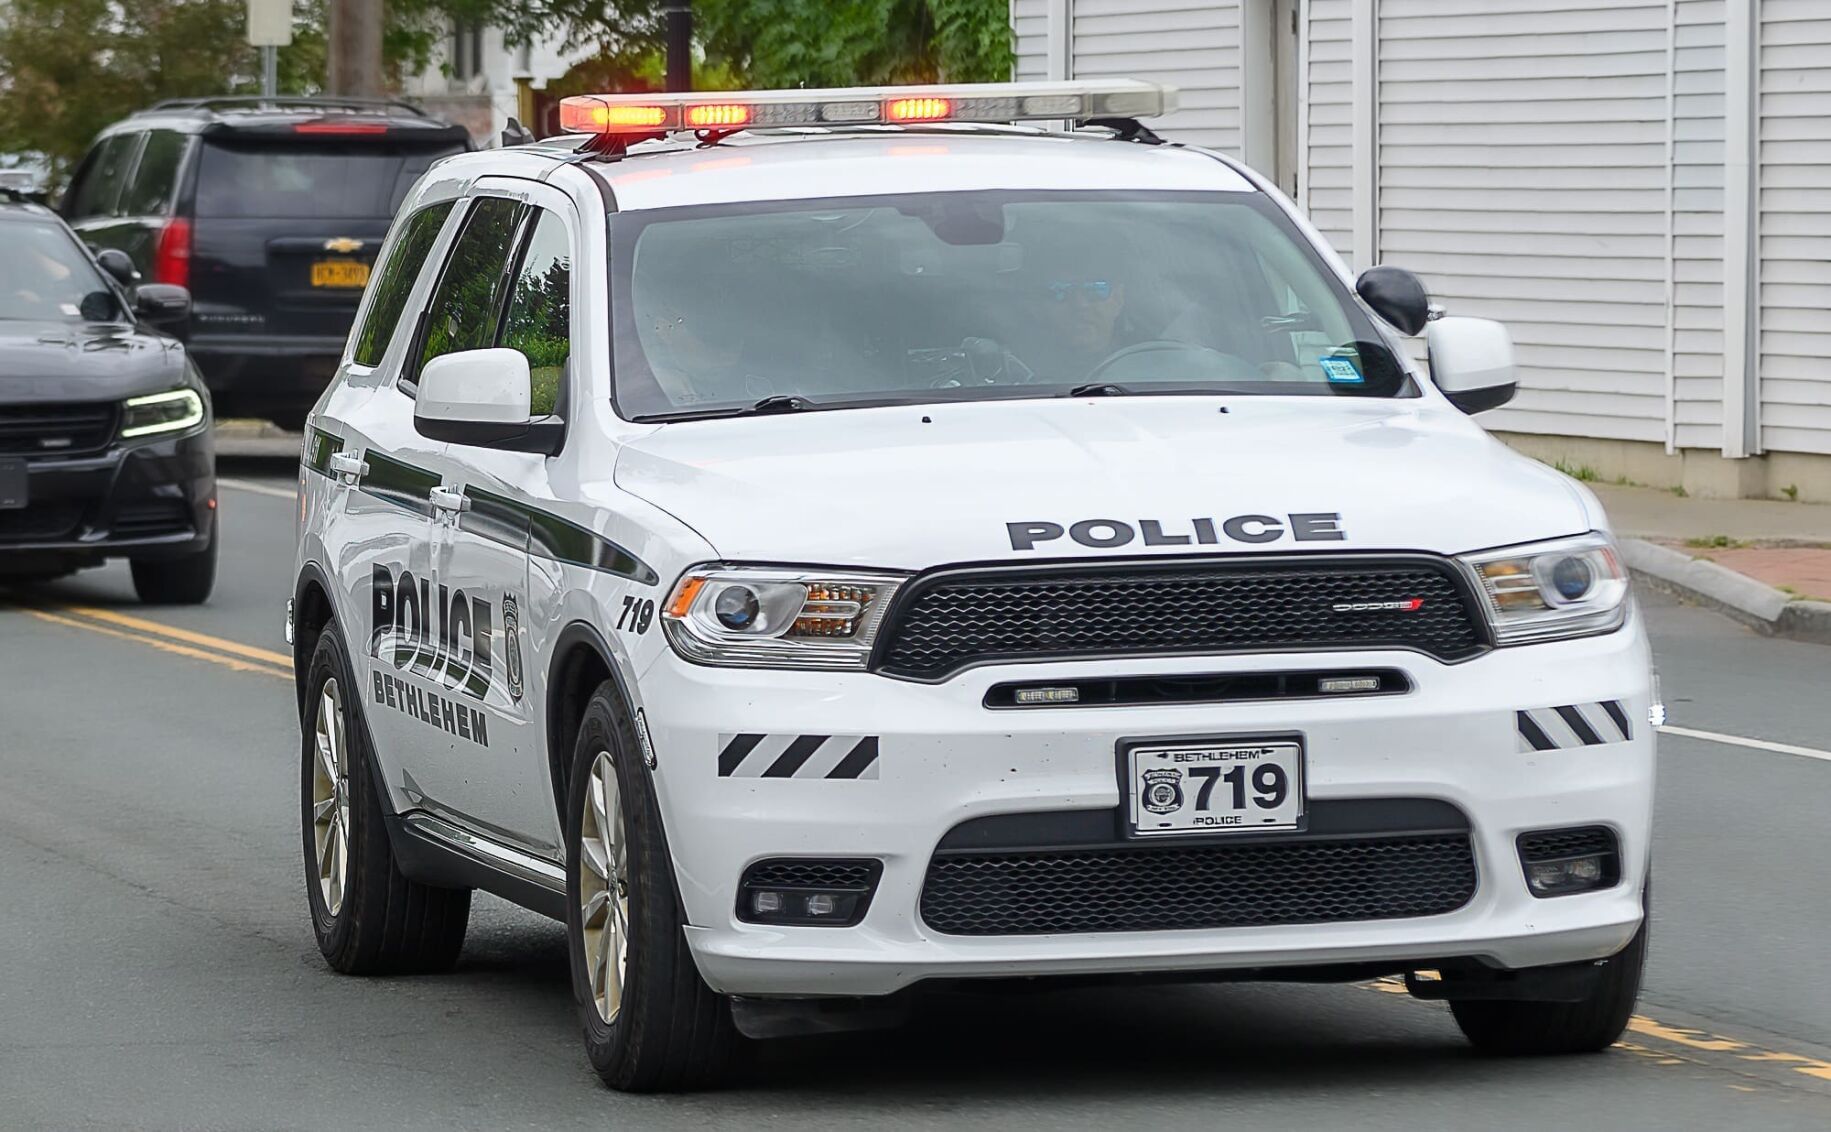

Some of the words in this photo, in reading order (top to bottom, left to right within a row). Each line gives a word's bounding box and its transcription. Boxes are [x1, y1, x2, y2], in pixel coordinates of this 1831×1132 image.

[1005, 512, 1348, 551] POLICE
[372, 562, 493, 700] POLICE
[616, 594, 654, 635] 719
[373, 669, 489, 747] BETHLEHEM
[1174, 749, 1260, 763] BETHLEHEM
[1188, 762, 1288, 811] 719
[1195, 815, 1242, 826] POLICE
